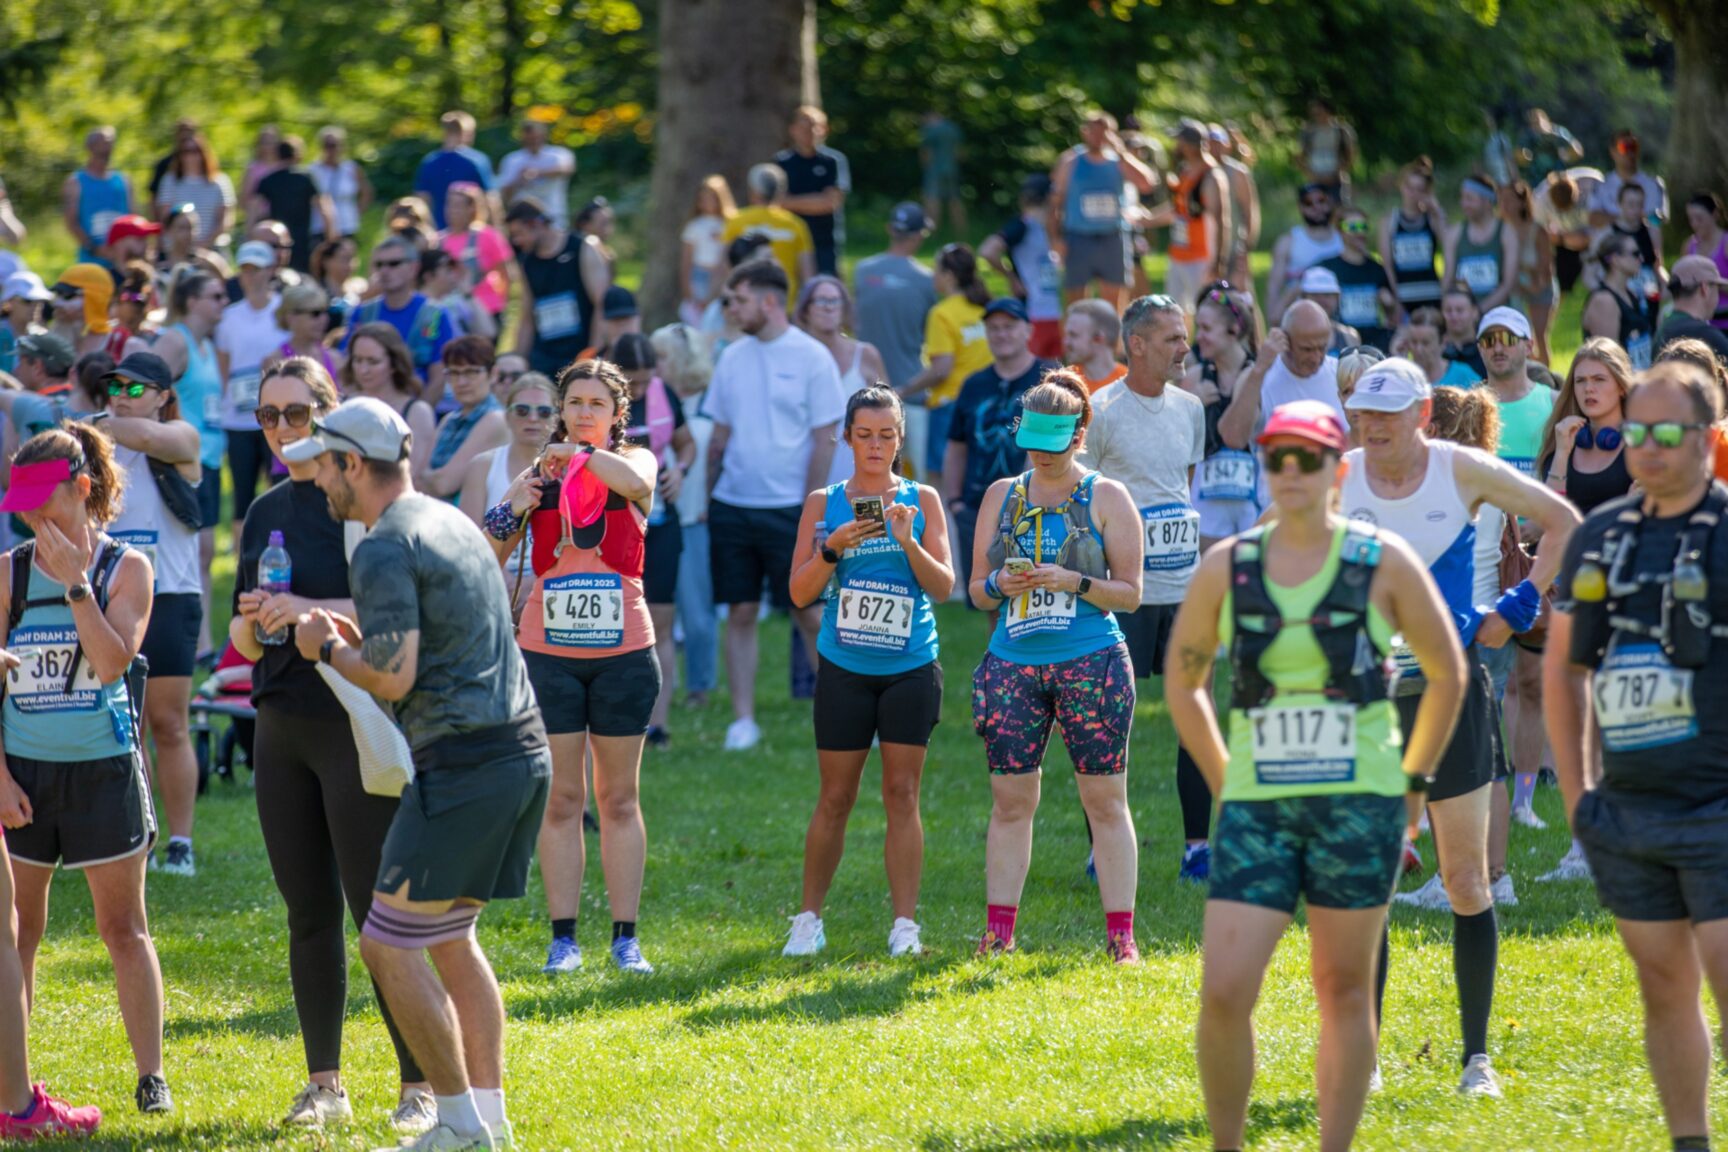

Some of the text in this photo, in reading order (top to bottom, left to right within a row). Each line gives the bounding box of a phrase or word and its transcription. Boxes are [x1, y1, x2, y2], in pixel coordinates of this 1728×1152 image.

[860, 536, 890, 547] rowth
[1162, 520, 1188, 545] 872
[568, 579, 593, 587] DRAM
[594, 579, 616, 587] 2025
[848, 578, 909, 595] Half DRAM 2025
[565, 593, 602, 619] 426
[857, 595, 896, 624] 672
[14, 630, 79, 642] Half DRAM 20
[858, 623, 890, 634] JOANNA
[31, 649, 73, 679] 362
[36, 682, 66, 692] ELAIN
[1617, 673, 1659, 711] 787
[1277, 709, 1325, 745] 117
